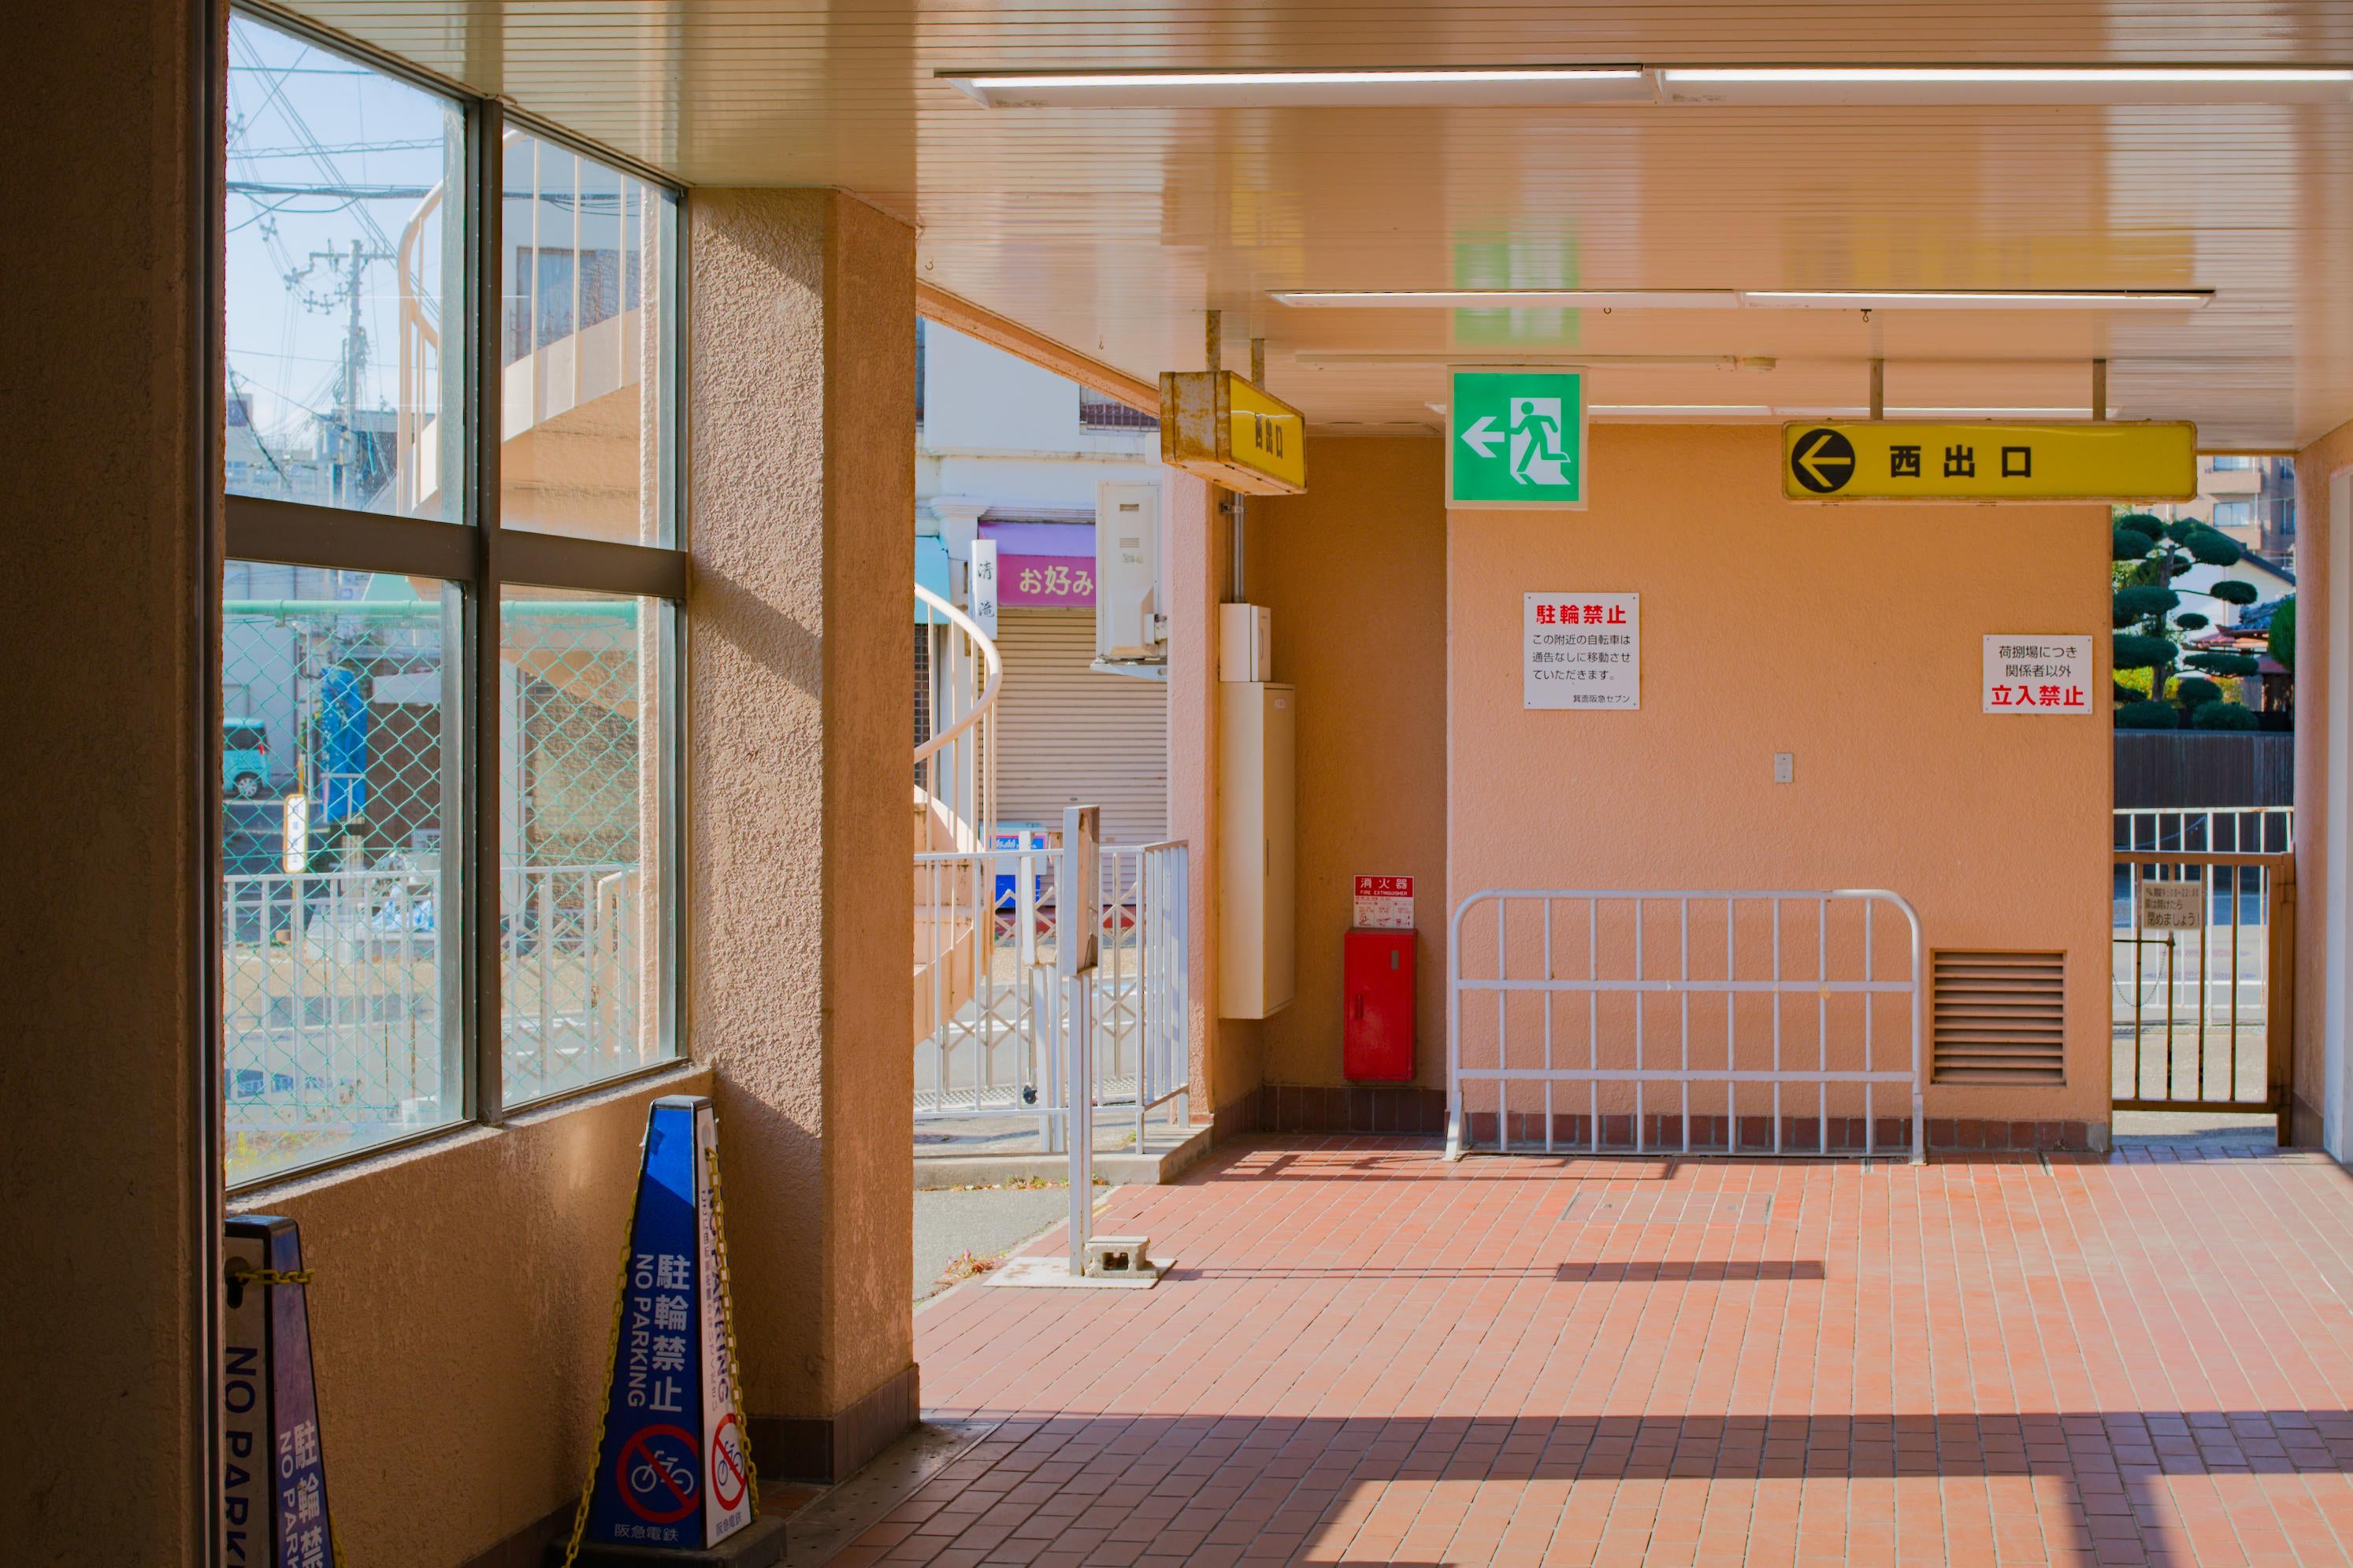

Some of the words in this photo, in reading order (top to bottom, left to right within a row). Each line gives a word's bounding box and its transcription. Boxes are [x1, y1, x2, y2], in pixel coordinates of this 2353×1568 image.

[1254, 413, 1283, 459] 西出口
[1889, 444, 2032, 478] 西出口
[1019, 565, 1094, 596] お好み
[1536, 604, 1627, 625] 駐輪禁止
[1533, 634, 1631, 646] この附近の自転車は
[1532, 651, 1631, 663] 通告なしに移動させ
[1999, 645, 2077, 659] 荷捌場につき
[1533, 669, 1614, 680] ていただきます。
[2006, 664, 2072, 678] 関係者以外
[1573, 694, 1631, 703] 箕面阪急セブン
[1991, 684, 2084, 706] 立入禁止
[1360, 877, 1408, 890] 消火器
[634, 1253, 654, 1290] NO
[648, 1253, 692, 1414] 駐輪禁止
[627, 1296, 652, 1408] PARKING
[226, 1346, 258, 1414] NO
[279, 1429, 295, 1481] NO
[614, 1523, 679, 1542] 阪急電鉄
